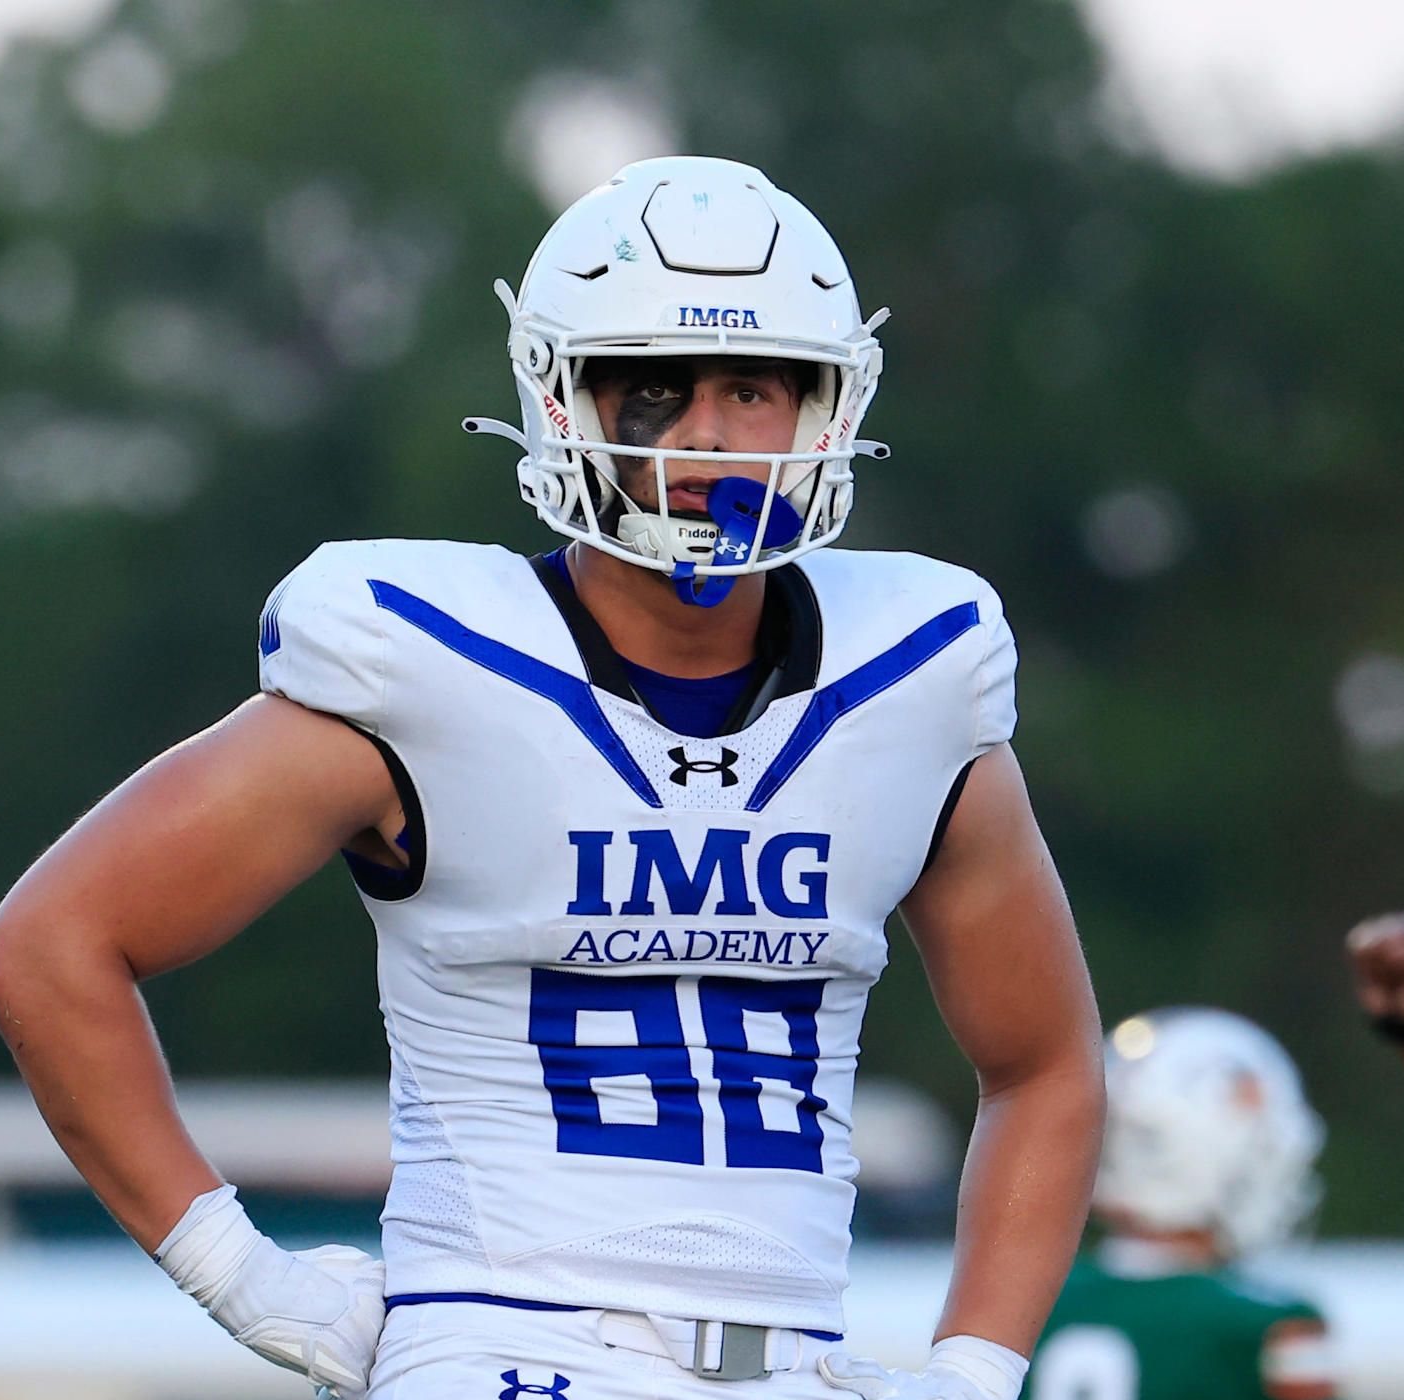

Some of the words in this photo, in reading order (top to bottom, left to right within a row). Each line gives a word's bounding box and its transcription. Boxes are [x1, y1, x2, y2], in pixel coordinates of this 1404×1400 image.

[677, 307, 762, 329] IMGA
[566, 828, 831, 919] IMG
[561, 929, 829, 965] ACADEMY
[528, 967, 836, 1174] 88
